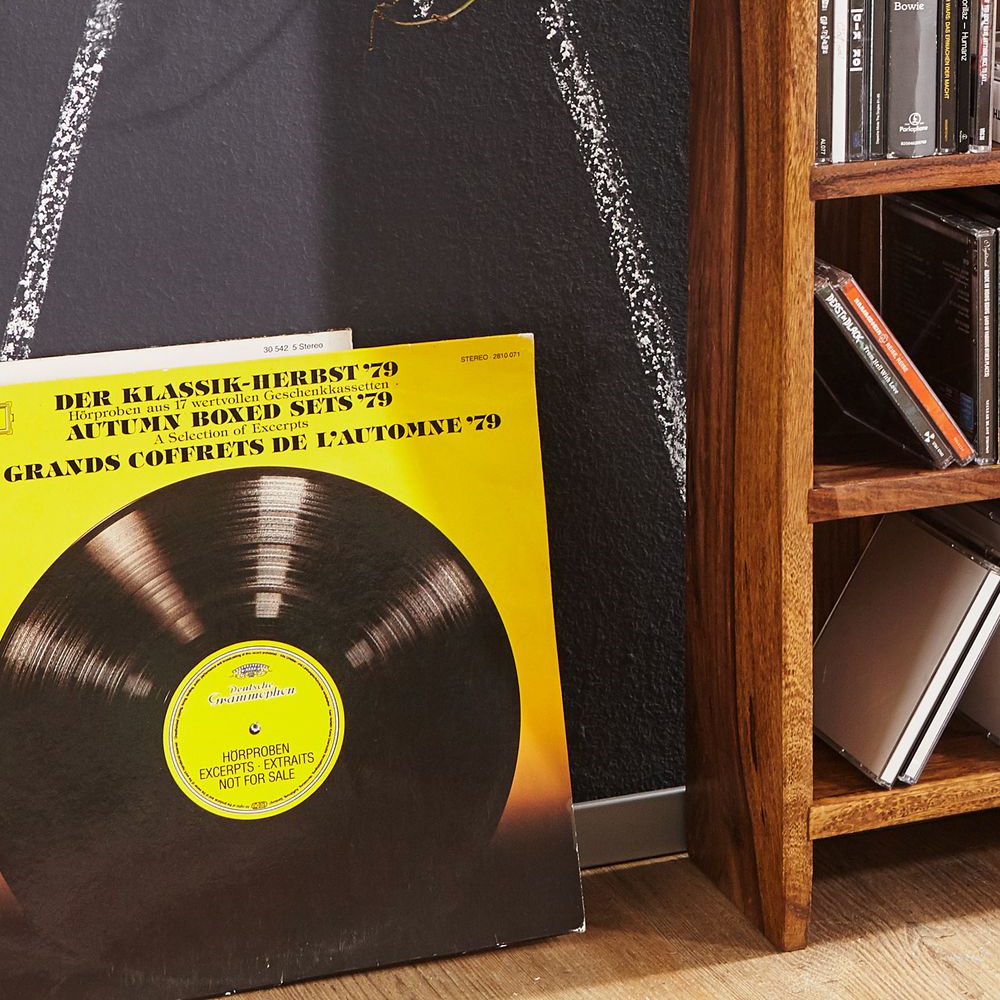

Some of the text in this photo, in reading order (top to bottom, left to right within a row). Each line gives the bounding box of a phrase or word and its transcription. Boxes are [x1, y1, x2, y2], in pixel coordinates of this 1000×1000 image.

[894, 1, 925, 11] Bowie
[960, 31, 969, 61] Humanz
[899, 126, 929, 134] Parlophone
[263, 346, 271, 354] 30
[274, 344, 288, 353] 542
[298, 342, 324, 351] Stereo
[460, 353, 489, 363] STEREO
[55, 390, 111, 411] DER
[123, 364, 361, 404] KLASSIK-HERBST
[69, 380, 389, 422] Hörproben aus 17 wertvollen Geschenkkassetten
[65, 414, 181, 442] AUTUMN
[192, 403, 281, 428] BOXED
[290, 394, 353, 418] SETS
[154, 418, 309, 445] A Selection of Excerpts
[3, 454, 121, 484] GRANDS
[128, 436, 266, 469] COFFRETS
[272, 433, 308, 454] DE
[208, 686, 296, 706] Grammophon
[229, 681, 275, 695] Deutsche
[222, 743, 290, 763] HÖRPROBEN
[199, 752, 315, 780] EXCERPTS EXTRAITS
[219, 768, 295, 790] NOT FOR SALE
